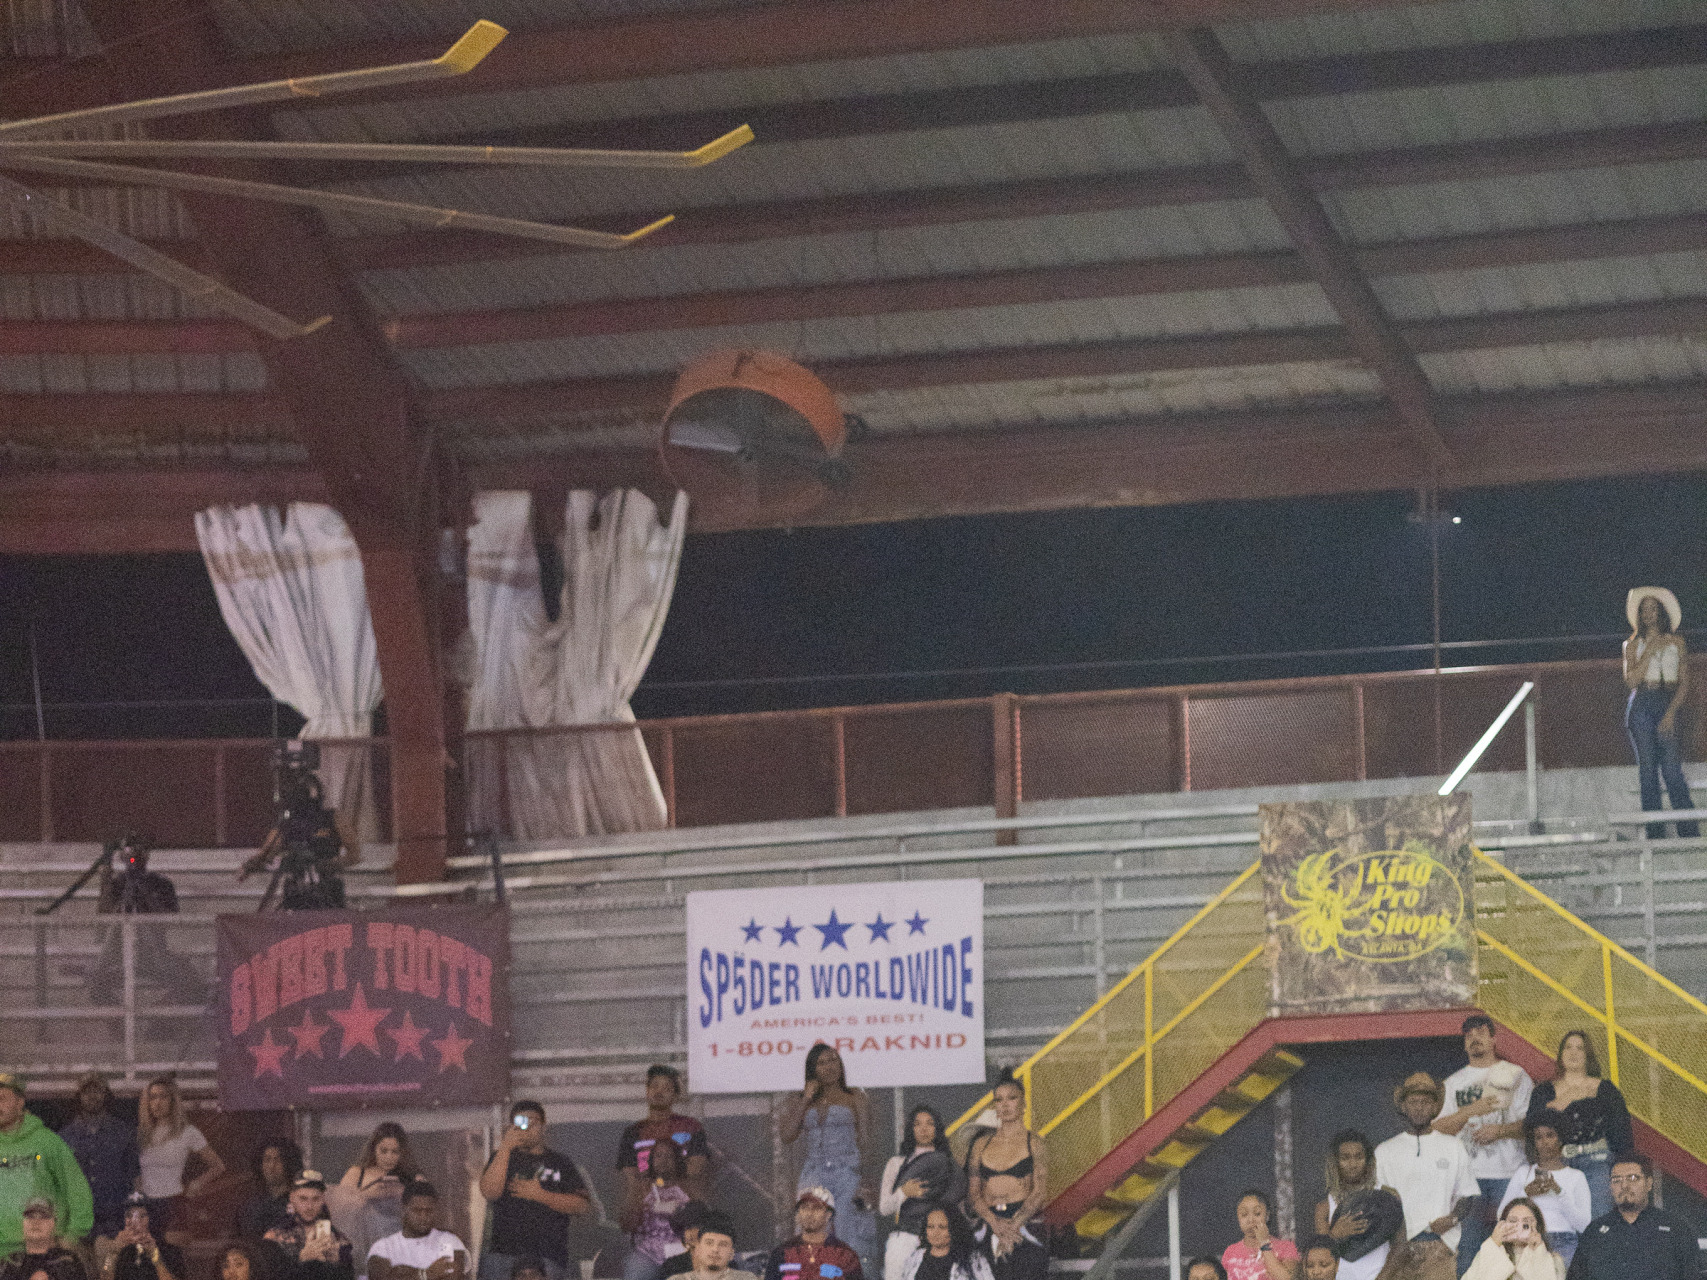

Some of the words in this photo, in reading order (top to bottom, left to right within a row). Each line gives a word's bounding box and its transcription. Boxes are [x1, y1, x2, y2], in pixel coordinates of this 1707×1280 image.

[1366, 857, 1433, 886] King
[1372, 885, 1421, 909] Pro
[1370, 909, 1452, 939] Shops
[231, 924, 352, 1037] SWEET
[366, 922, 493, 1027] TOOTH
[811, 935, 974, 1019] WORLDWIDE
[750, 1015, 859, 1030] AMERICA'S
[865, 1012, 925, 1025] BEST!
